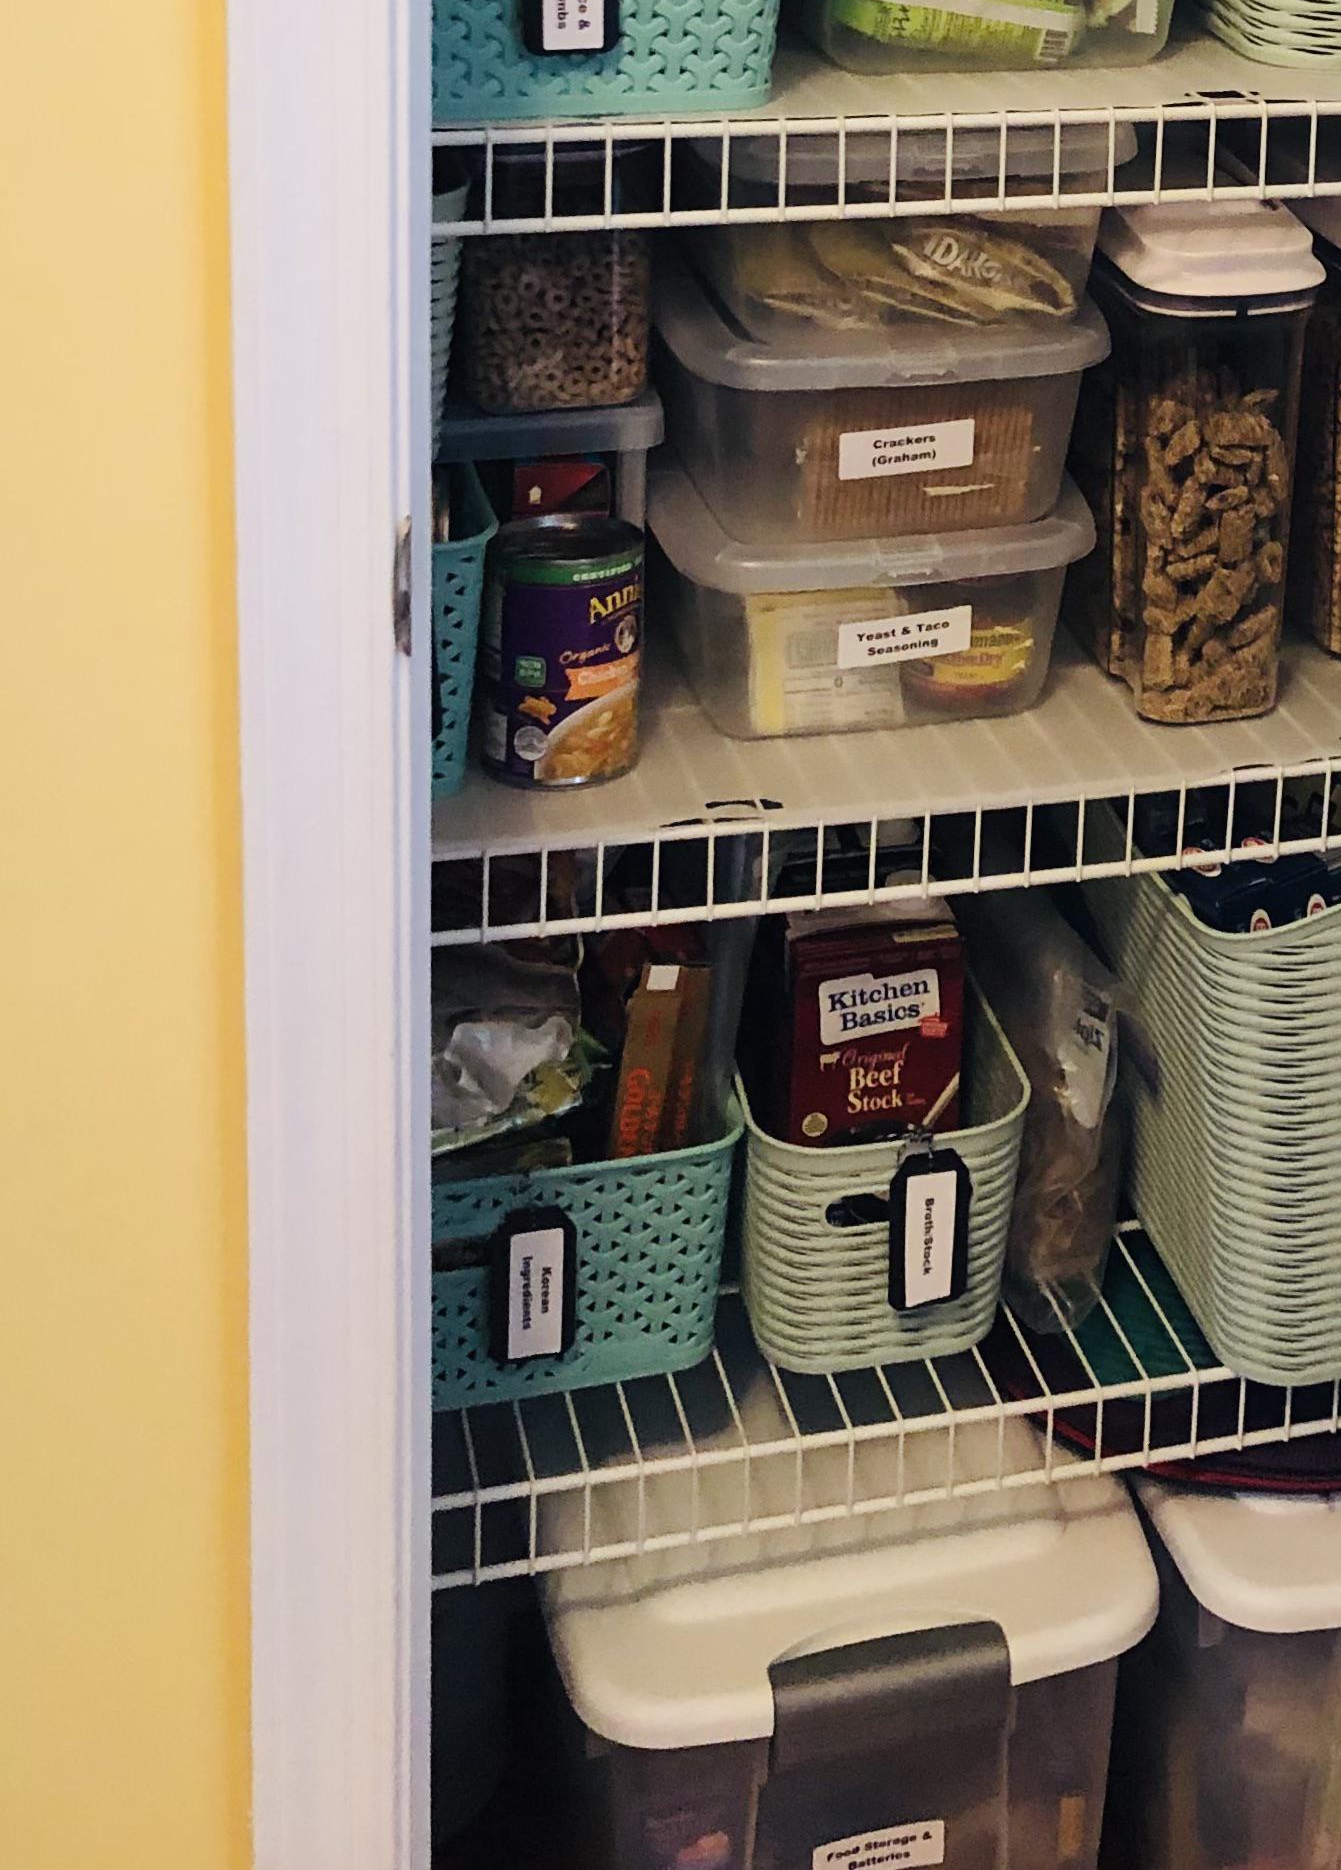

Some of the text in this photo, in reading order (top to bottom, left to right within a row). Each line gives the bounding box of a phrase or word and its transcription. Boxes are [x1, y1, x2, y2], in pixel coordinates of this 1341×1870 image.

[873, 433, 936, 450] Crackers
[871, 448, 938, 468] (Graham)
[856, 620, 950, 642] Yeast & Taco
[559, 643, 611, 666] Organic
[867, 638, 939, 657] Seasoning
[828, 979, 932, 1013] Kitchen
[840, 1003, 920, 1032] Basics
[842, 1041, 911, 1070] Original
[850, 1059, 905, 1090] Beef
[847, 1088, 904, 1114] Stock
[519, 1255, 534, 1331] Ingredients
[541, 1266, 553, 1314] Korean
[826, 1844, 861, 1863] Food
[864, 1833, 918, 1852] Storage
[847, 1850, 911, 1870] Batteries
